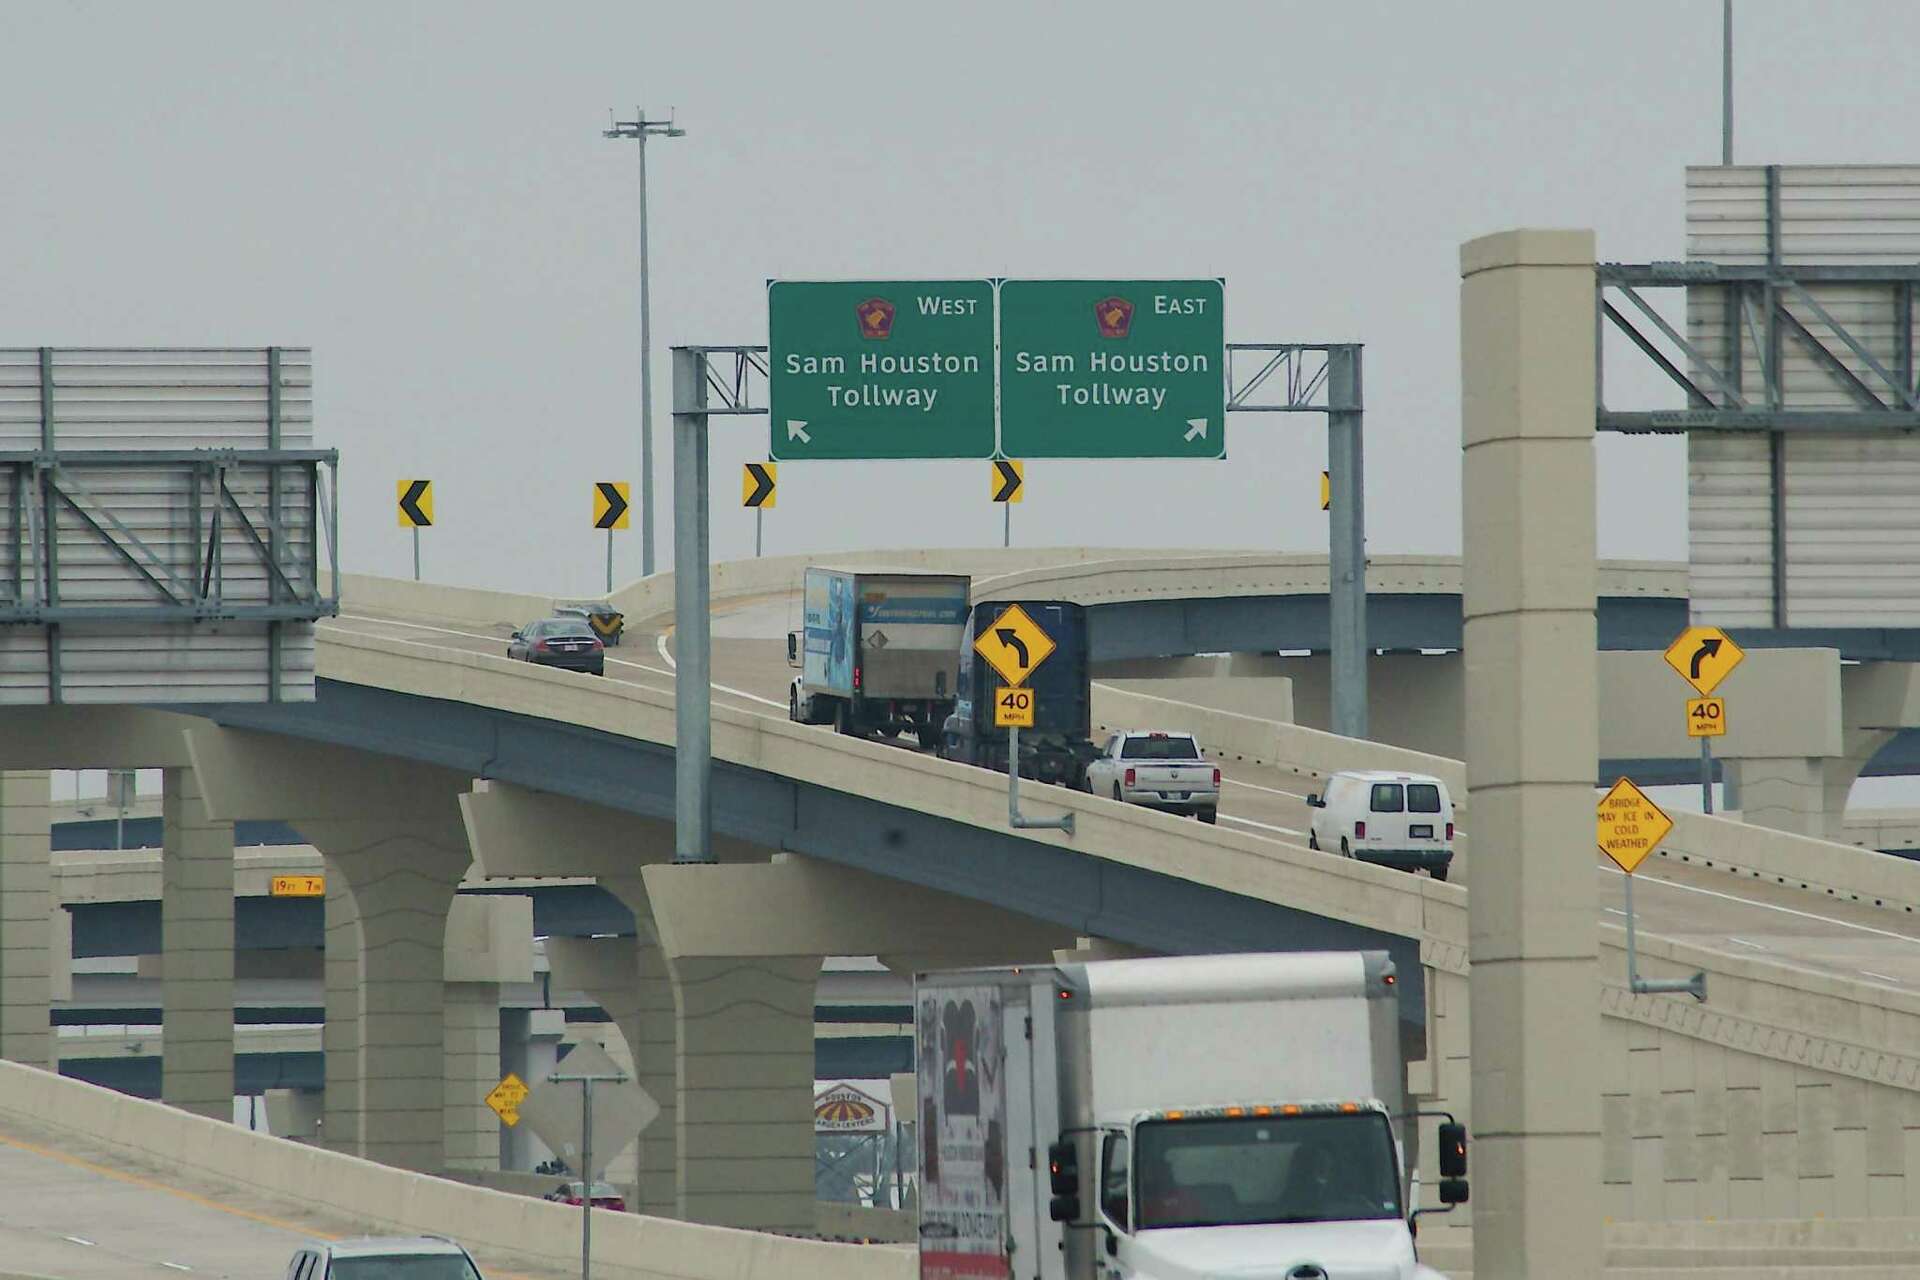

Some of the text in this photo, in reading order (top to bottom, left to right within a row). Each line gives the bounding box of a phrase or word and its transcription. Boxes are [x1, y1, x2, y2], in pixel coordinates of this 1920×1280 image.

[917, 296, 977, 315] WEST
[1154, 295, 1207, 315] EAST
[786, 352, 979, 374] Sam Houston
[1016, 351, 1209, 373] Sam Houston
[827, 384, 938, 411] Tollway
[1056, 383, 1167, 410] Tollway
[1001, 693, 1029, 710] 40
[1004, 713, 1025, 721] MPH
[1692, 703, 1720, 719] 40
[1609, 798, 1640, 809] BRIDGE
[1623, 811, 1637, 822] ICE
[1644, 810, 1655, 821] IN
[1614, 825, 1639, 836] COLD
[1606, 838, 1649, 849] WEATHER
[276, 880, 287, 892] 19
[306, 880, 313, 892] 7
